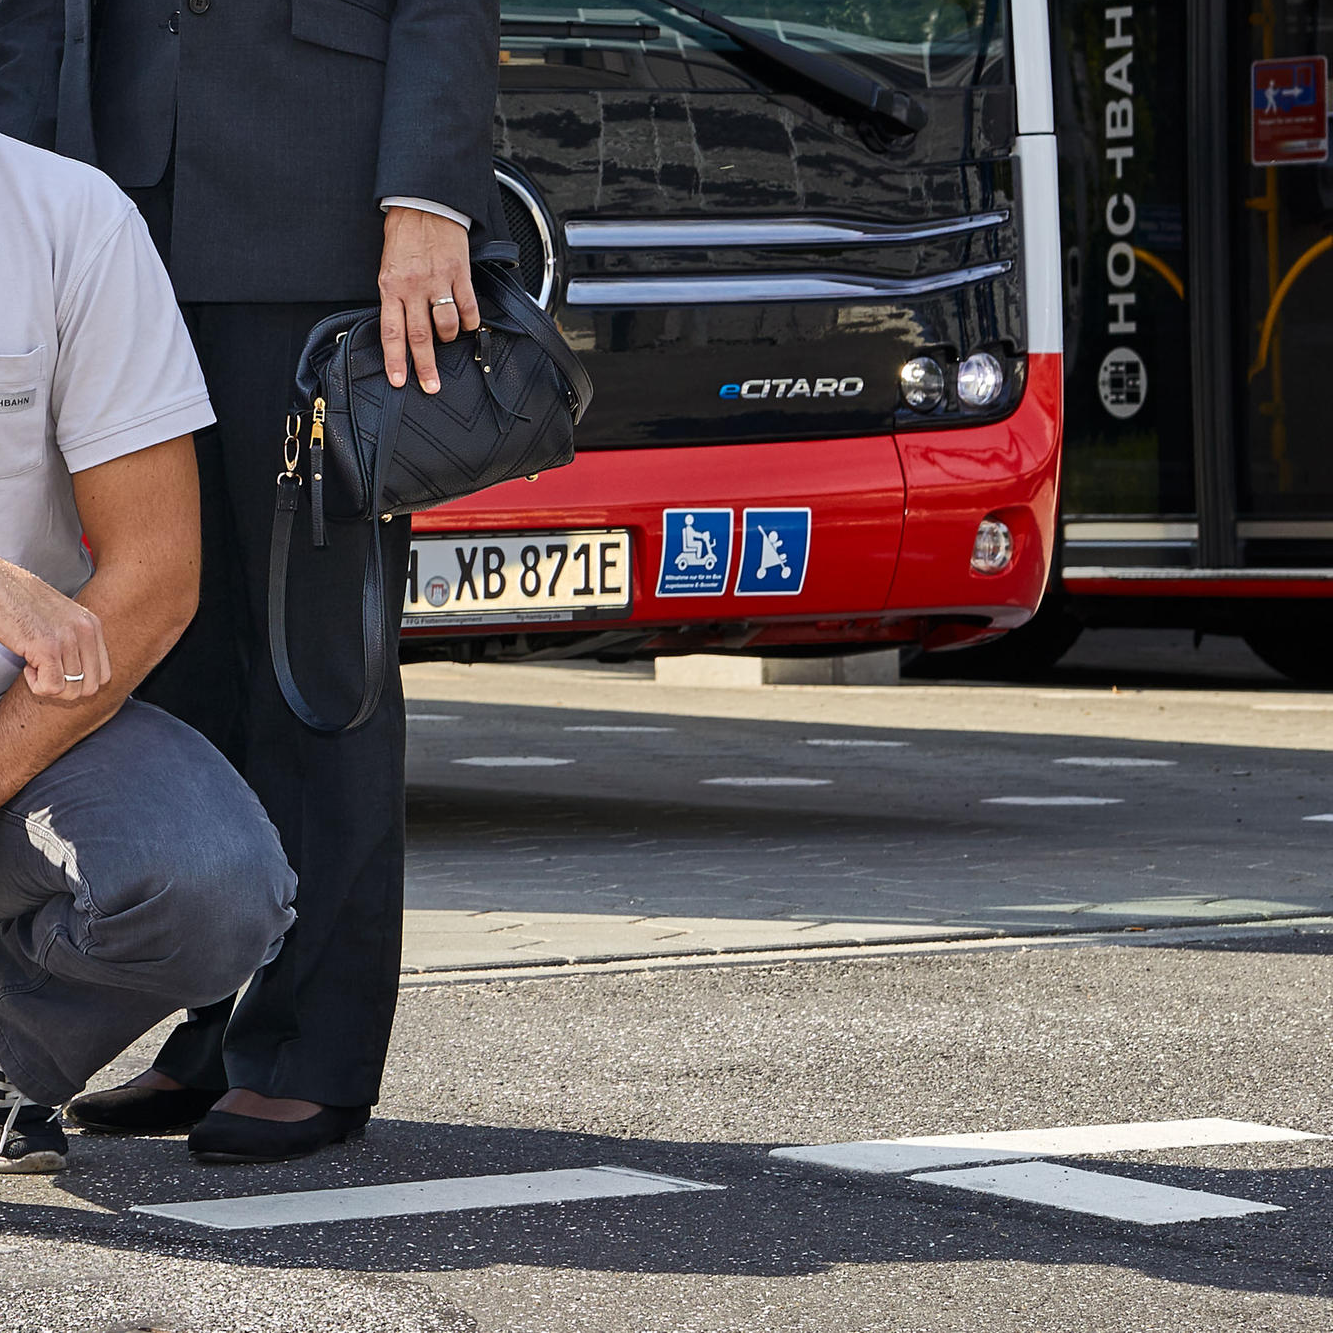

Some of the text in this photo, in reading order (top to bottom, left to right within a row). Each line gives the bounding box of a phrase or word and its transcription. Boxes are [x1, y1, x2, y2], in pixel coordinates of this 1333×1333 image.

[718, 376, 864, 401] eCITARO
[455, 546, 507, 601] XB
[520, 542, 622, 598] 871E
